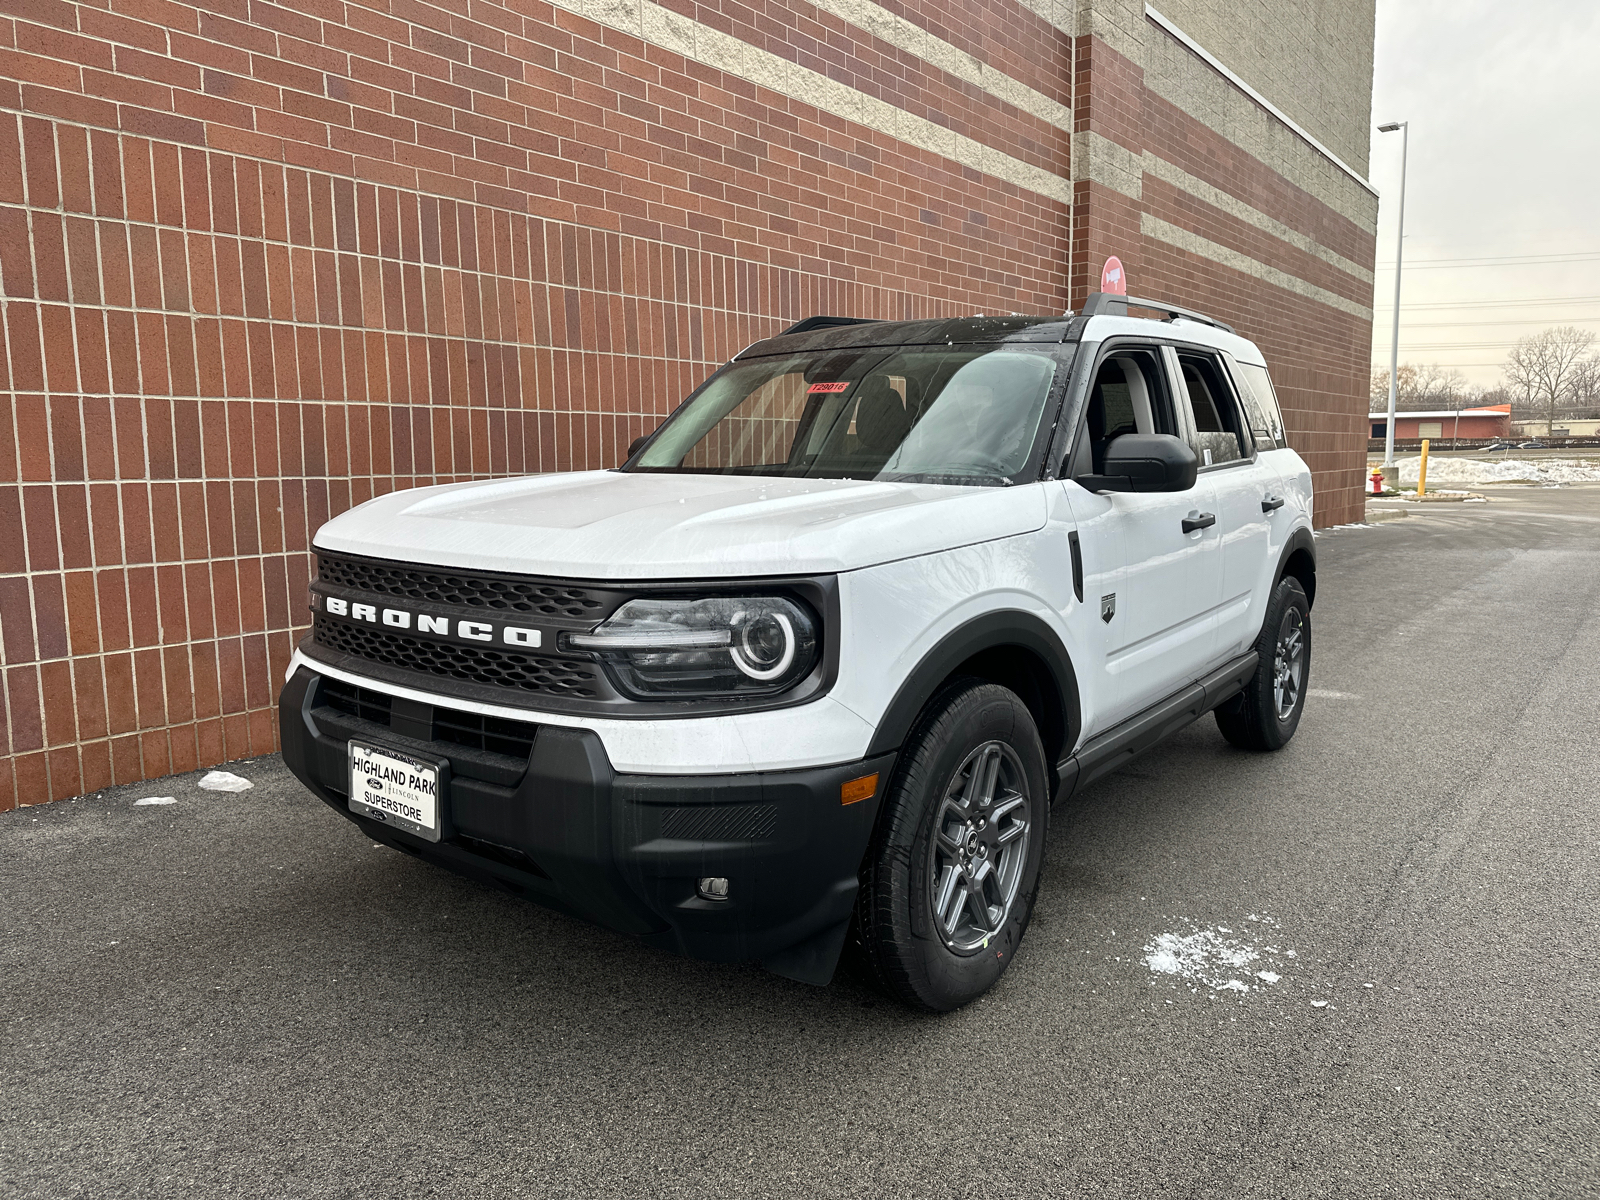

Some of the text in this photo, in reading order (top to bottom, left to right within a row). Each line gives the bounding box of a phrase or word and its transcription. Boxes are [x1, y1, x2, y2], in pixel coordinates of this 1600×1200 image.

[812, 383, 846, 391] T29016
[326, 596, 542, 648] BRONCO
[353, 756, 436, 796] HIGHLAND PARK
[368, 778, 383, 789] Ford
[392, 787, 420, 802] LINCOLN
[364, 791, 422, 821] SUPERSTORE
